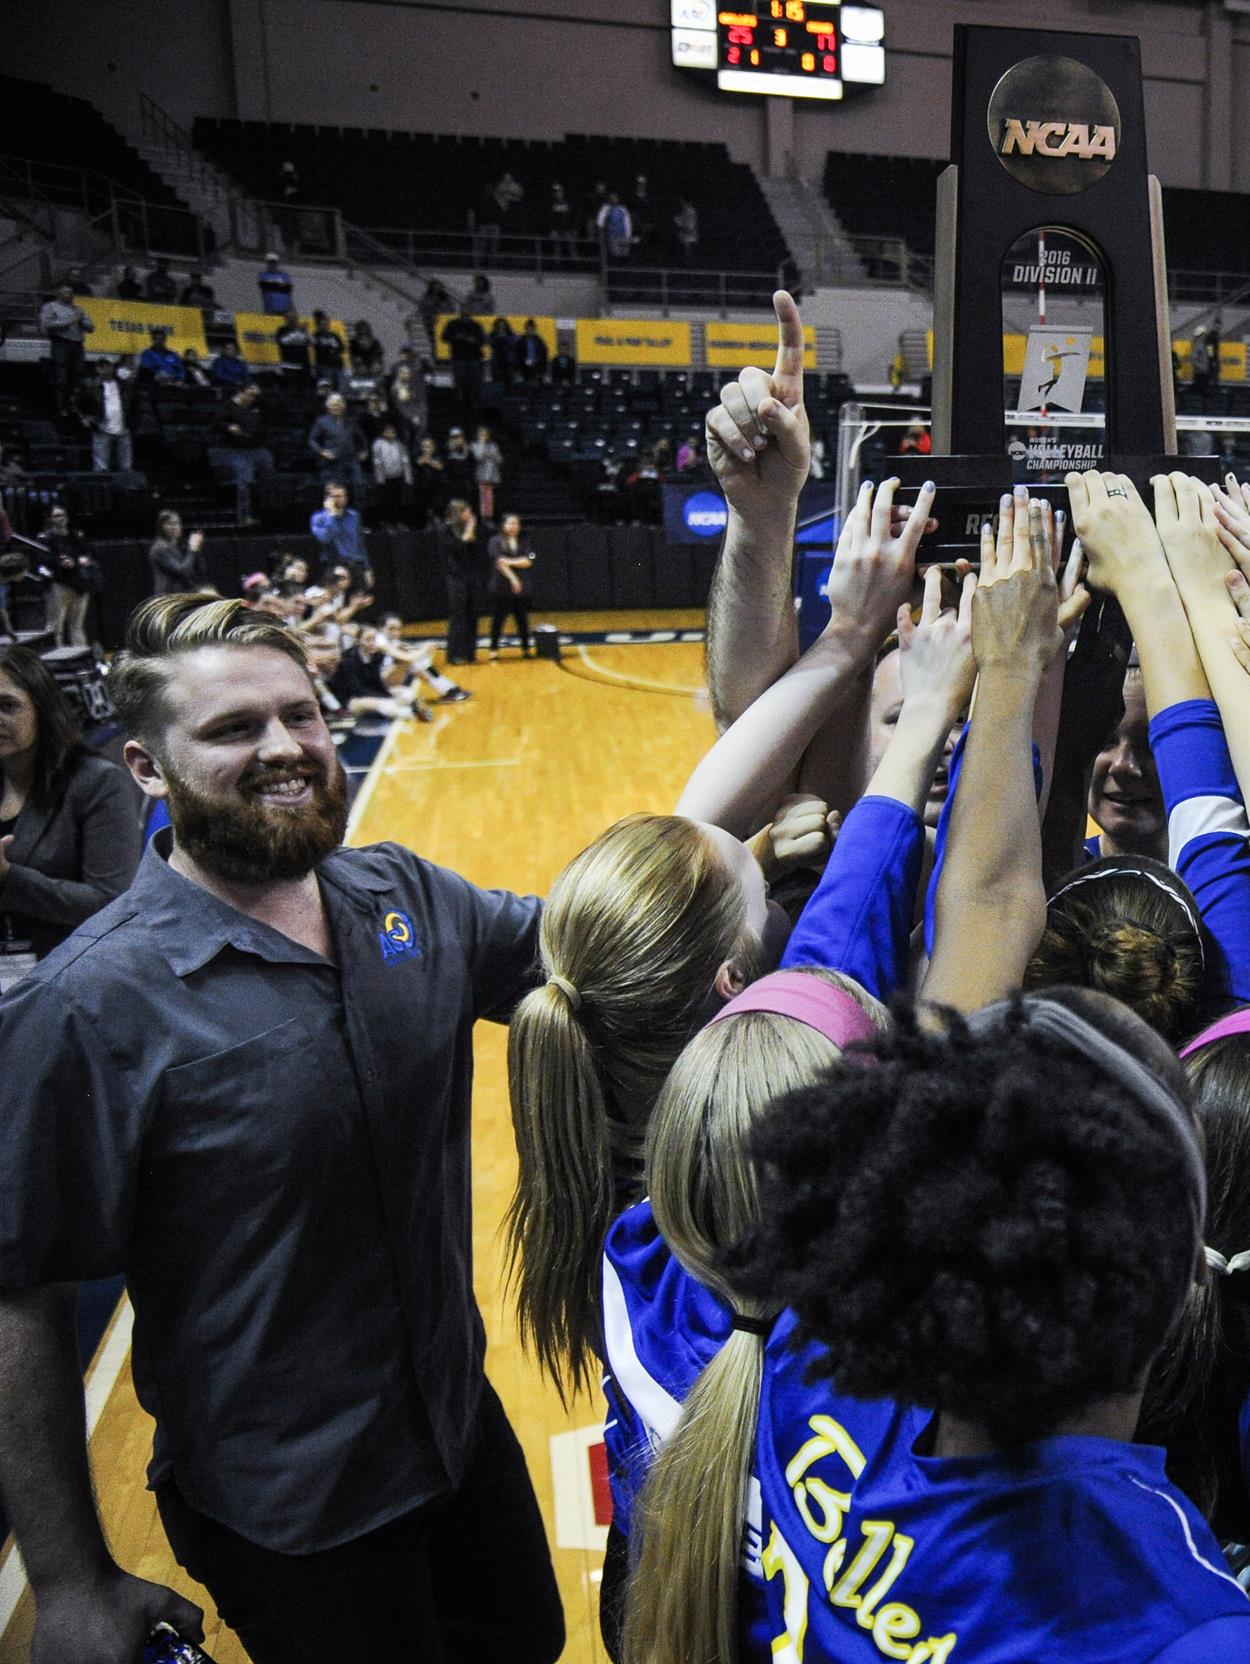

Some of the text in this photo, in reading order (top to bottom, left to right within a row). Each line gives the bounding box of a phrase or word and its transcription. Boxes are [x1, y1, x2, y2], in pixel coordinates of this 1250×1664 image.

[1000, 118, 1118, 162] NCAA
[1039, 249, 1071, 267] 2016
[1013, 265, 1098, 286] DIVISION II
[1027, 443, 1105, 460] VOLLEYBALL
[1026, 458, 1098, 471] CHAMPIONSHIP
